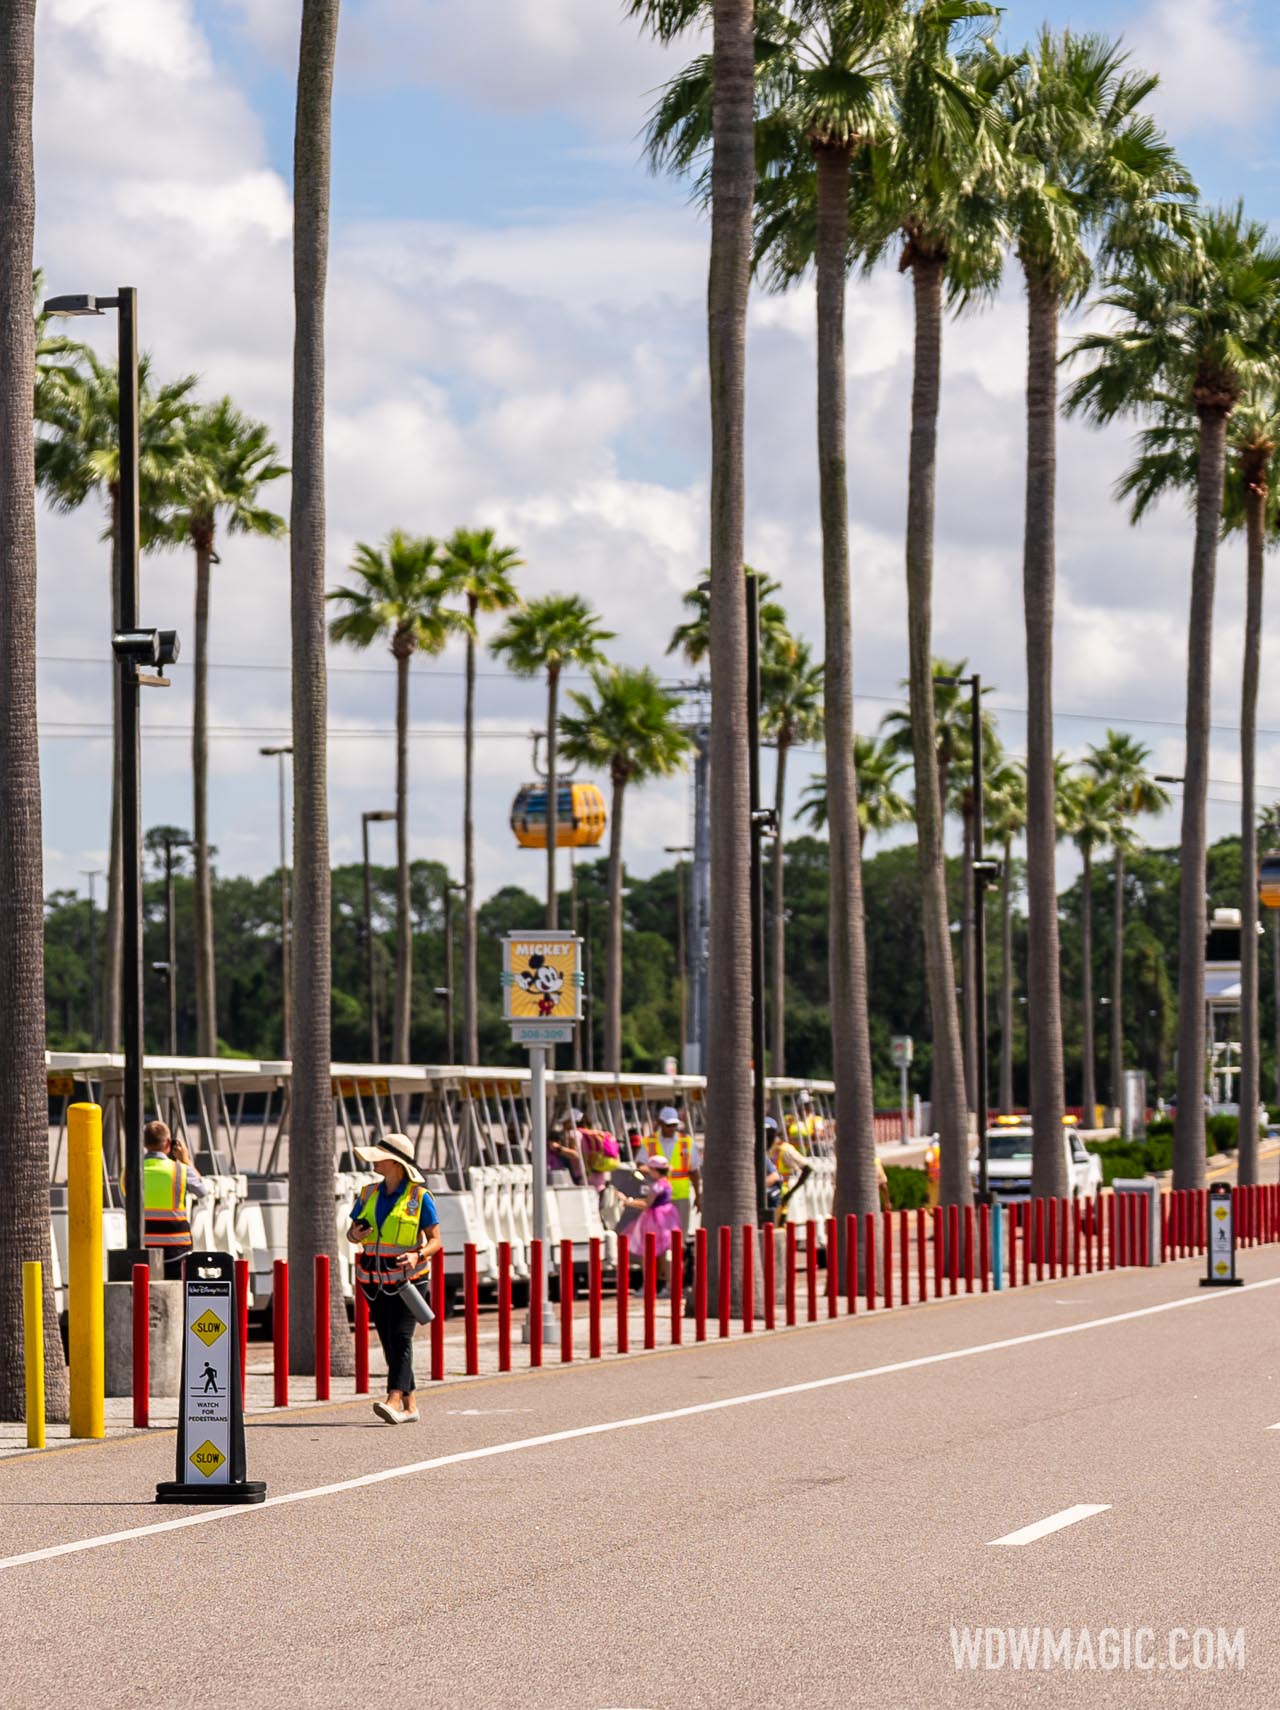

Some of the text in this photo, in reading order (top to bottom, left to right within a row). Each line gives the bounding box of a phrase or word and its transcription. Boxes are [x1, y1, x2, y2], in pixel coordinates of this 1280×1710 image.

[516, 944, 570, 955] MICKEY
[197, 1322, 220, 1333] SLOW
[196, 1452, 220, 1463] SLOW
